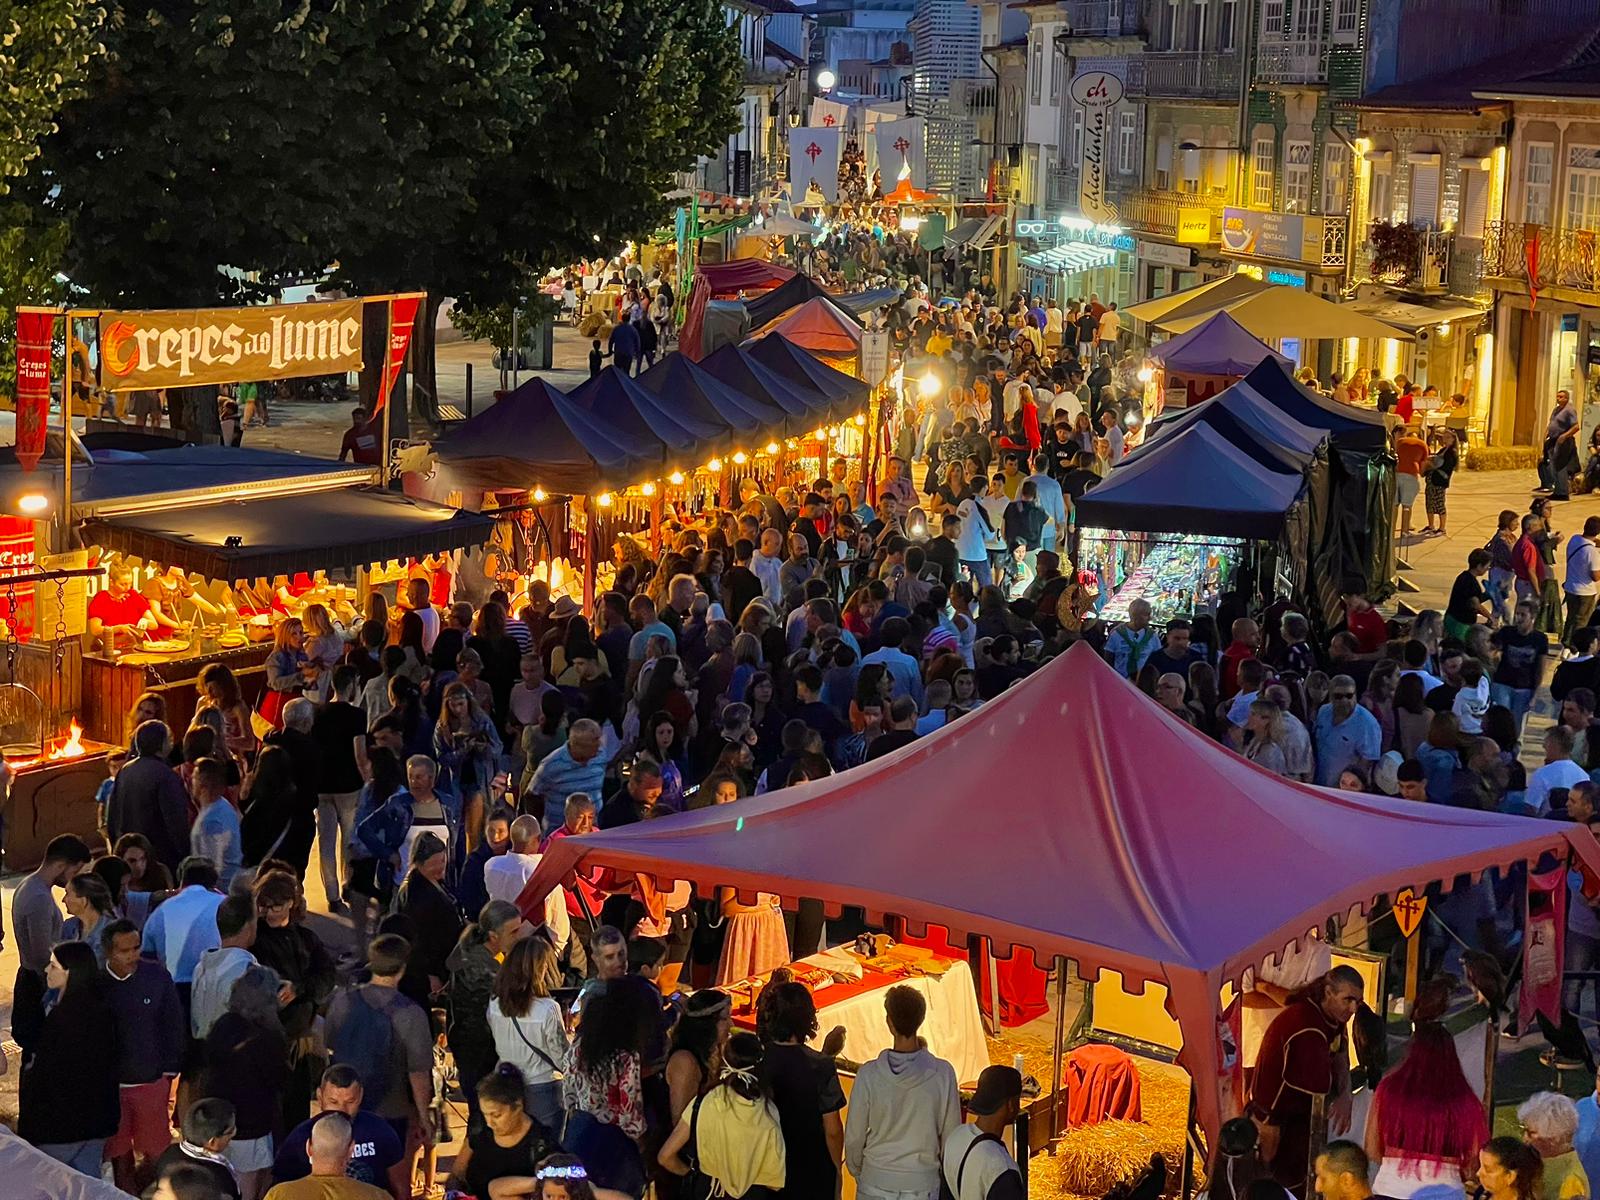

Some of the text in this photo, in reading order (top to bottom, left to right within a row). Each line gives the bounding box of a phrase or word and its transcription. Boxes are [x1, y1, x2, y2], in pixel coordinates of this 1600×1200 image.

[1087, 76, 1108, 98] ch
[1182, 221, 1207, 231] Hertz
[103, 314, 362, 377] Crepes ao lume
[19, 357, 47, 371] Crepes
[25, 368, 47, 379] lume
[351, 1141, 376, 1159] BES
